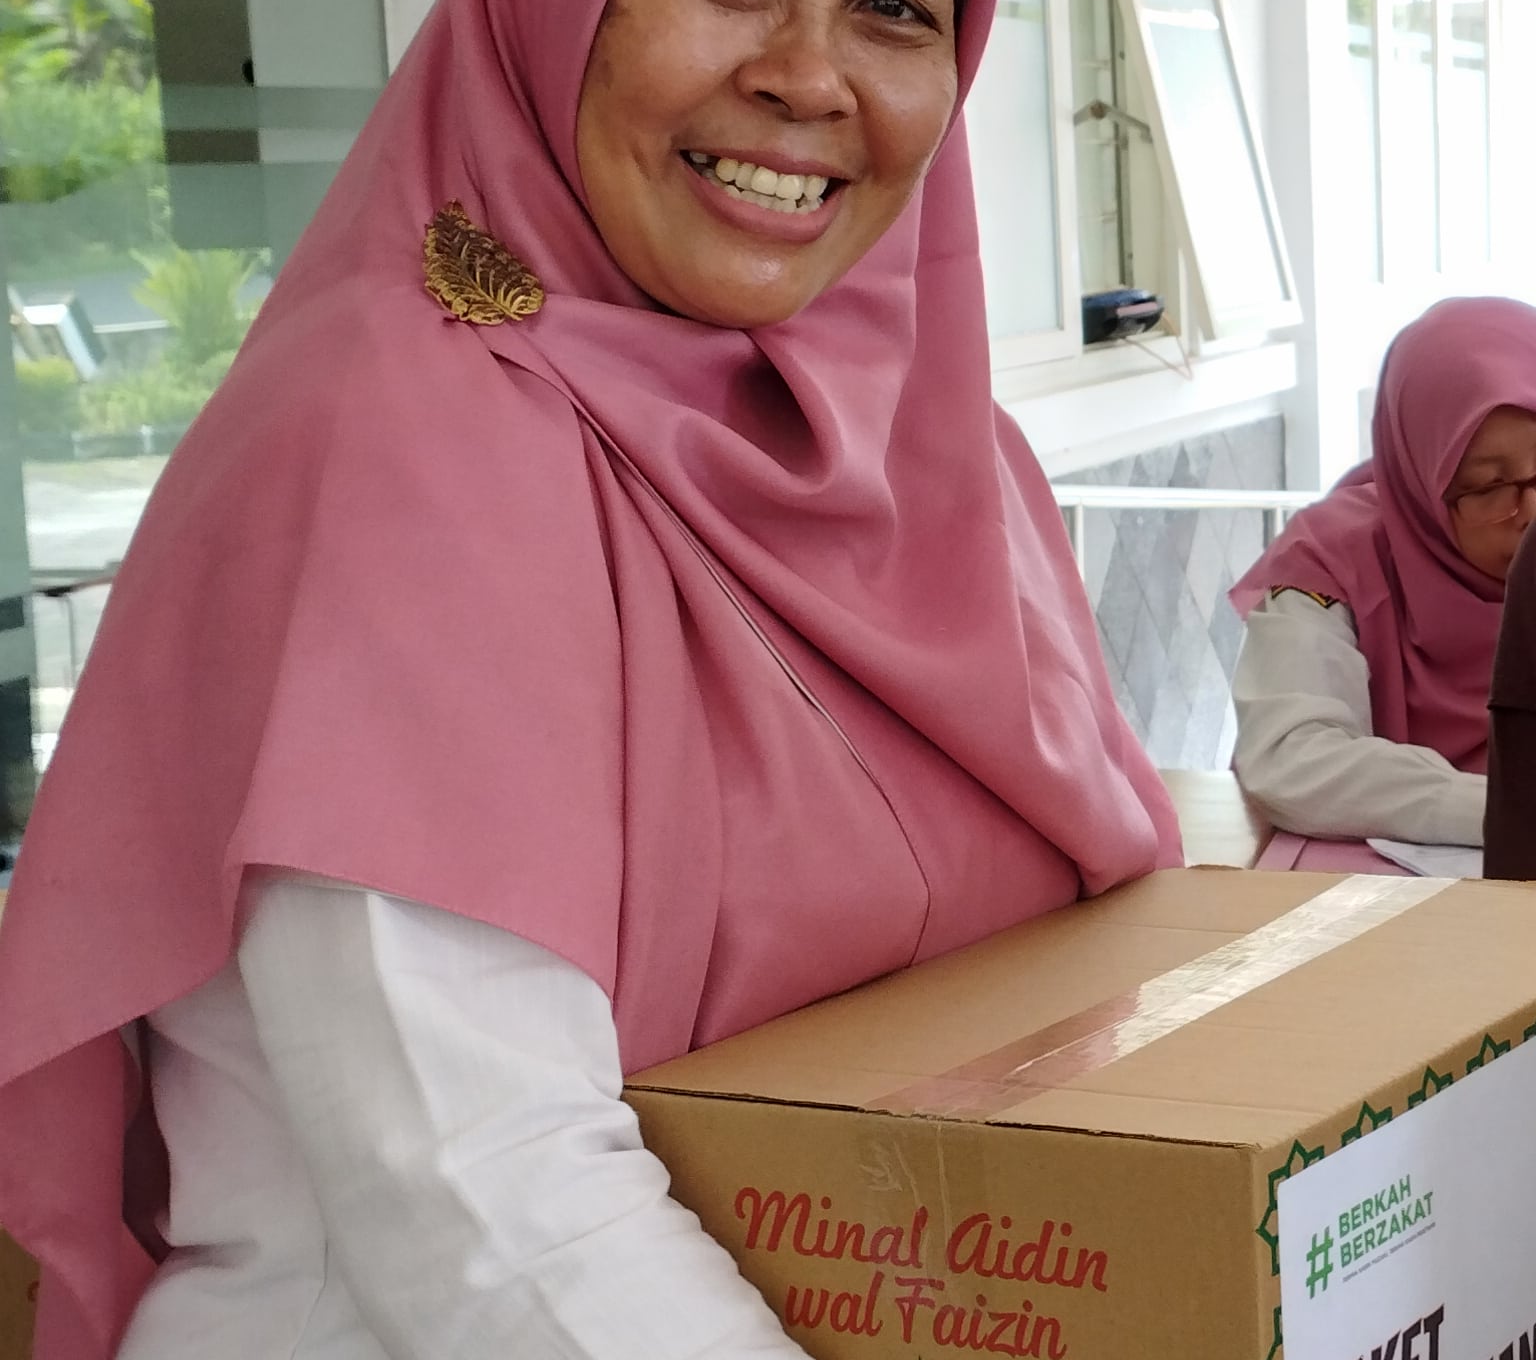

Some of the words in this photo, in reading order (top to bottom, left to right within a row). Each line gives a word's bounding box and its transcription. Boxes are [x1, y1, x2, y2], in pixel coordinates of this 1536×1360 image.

[734, 1186, 929, 1269] Minal
[946, 1212, 1109, 1293] Aidin
[1338, 1173, 1412, 1239] BERKAH
[1340, 1191, 1434, 1269] BERZAKAT
[785, 1271, 885, 1337] wal
